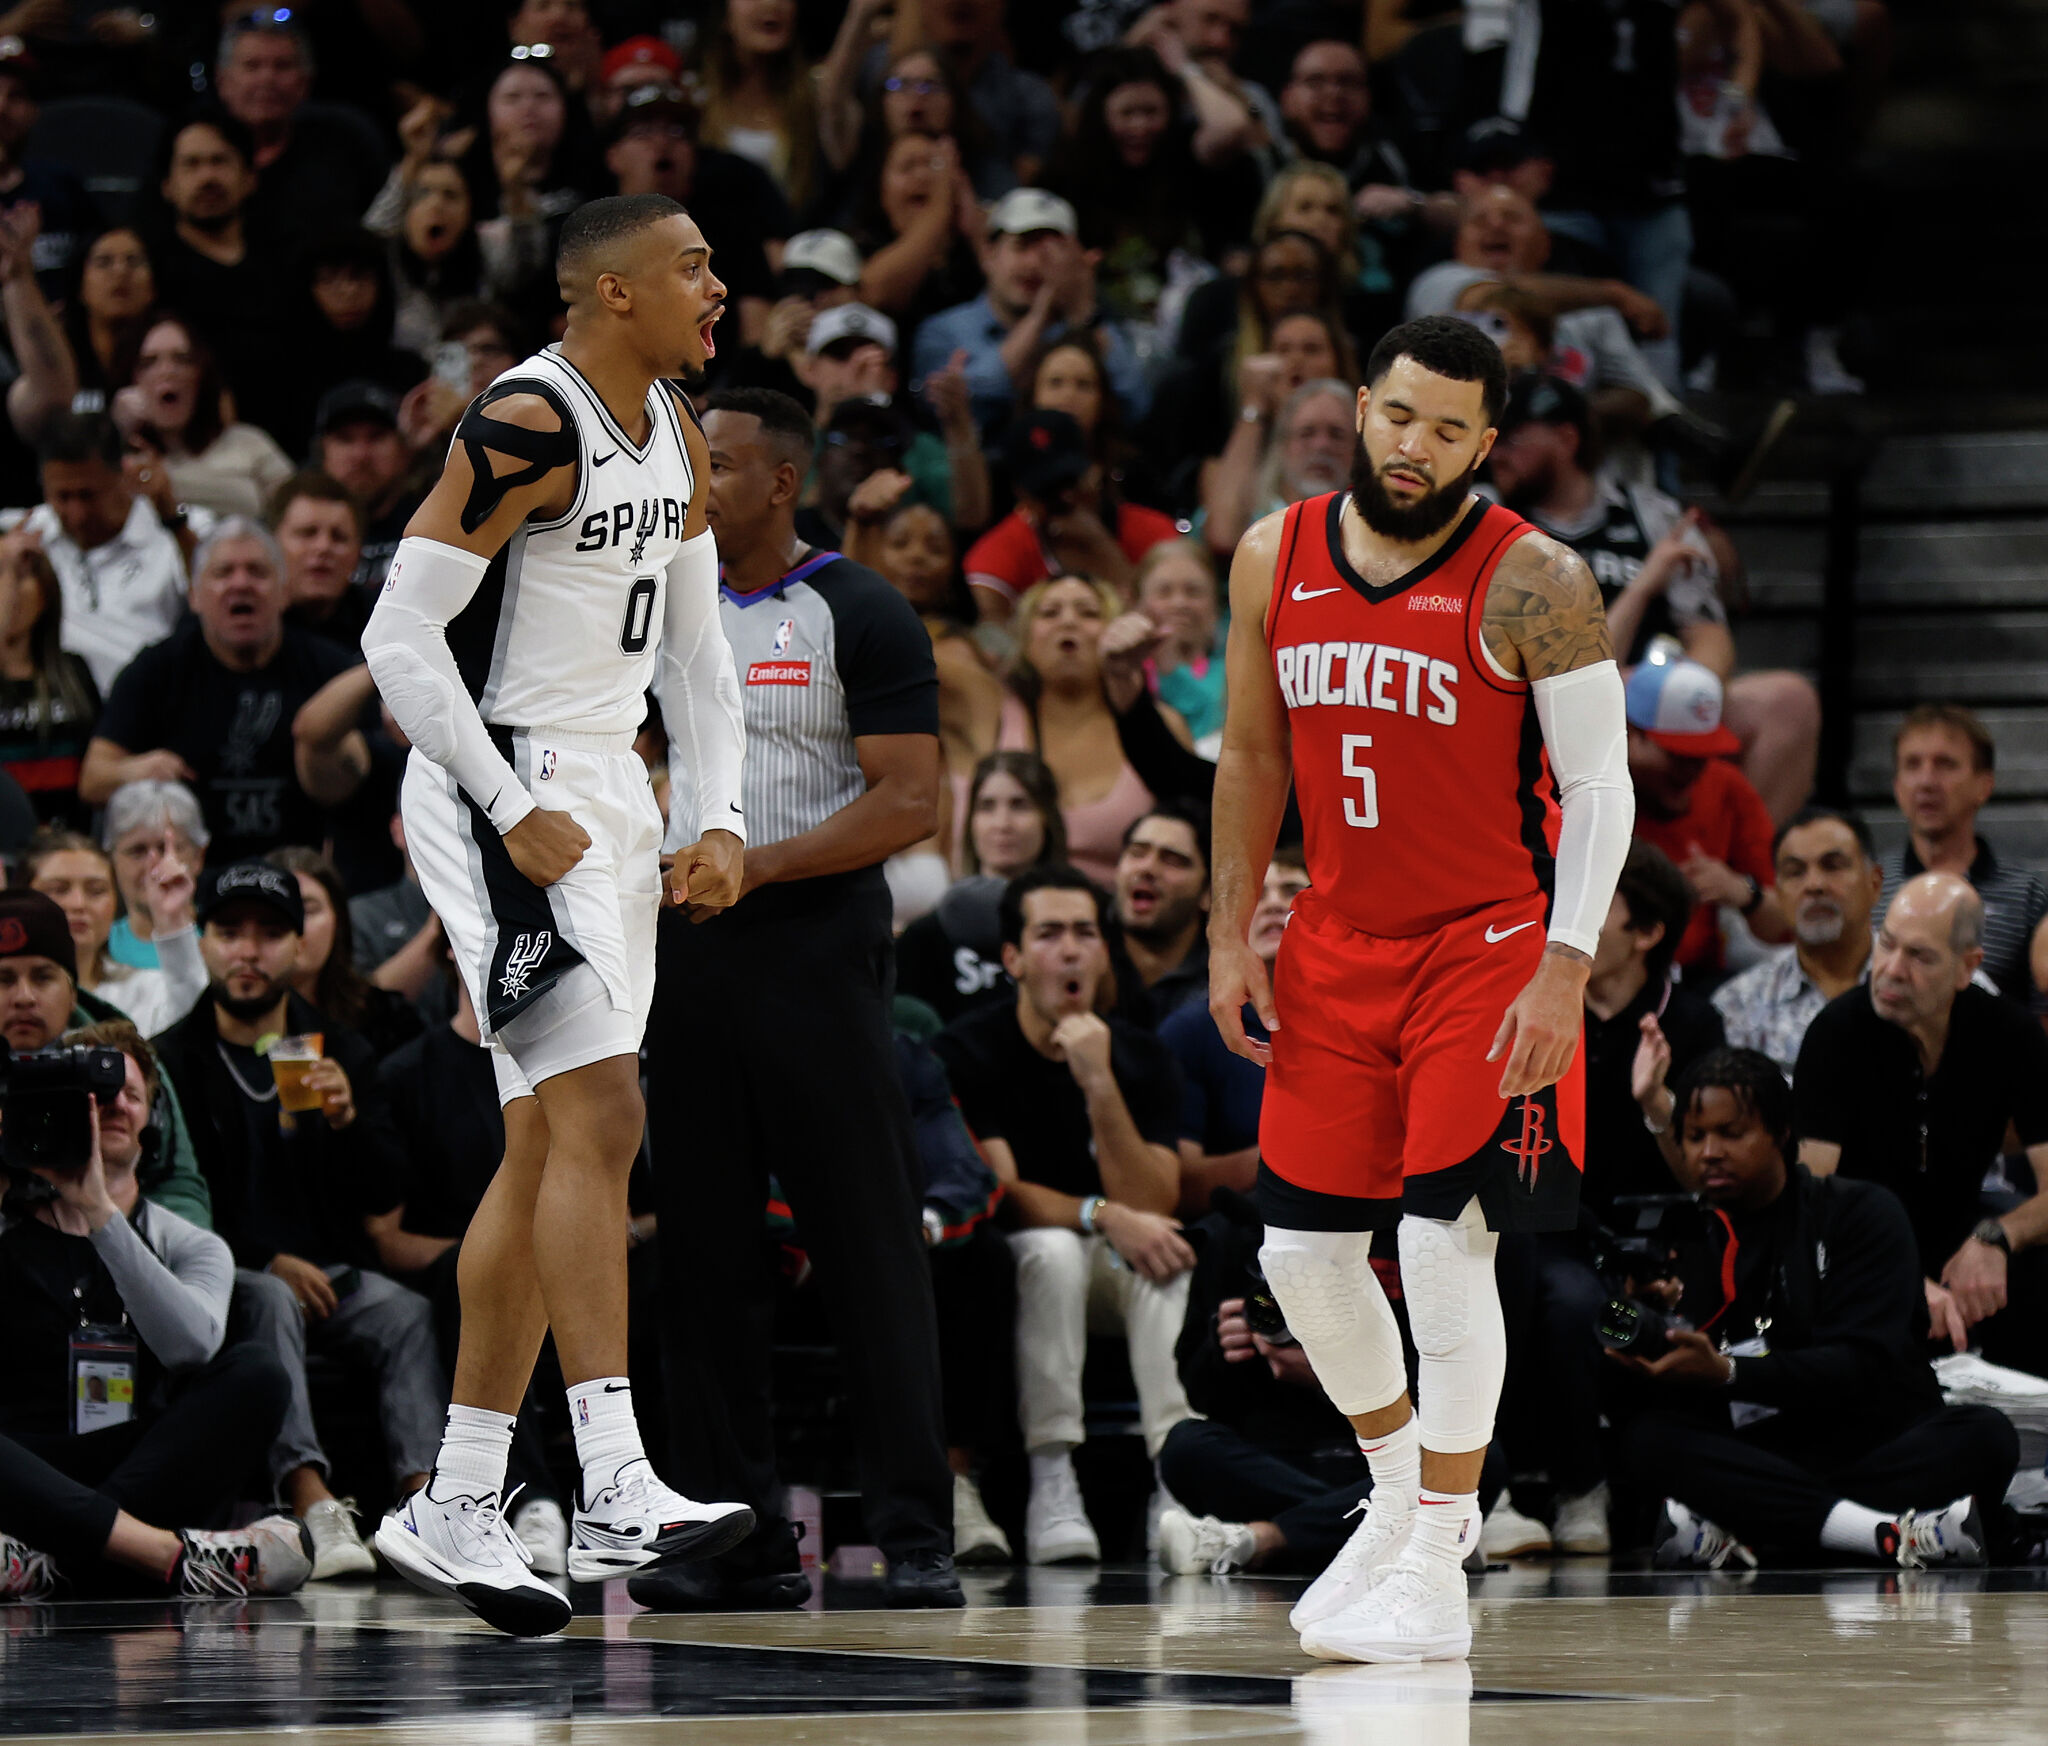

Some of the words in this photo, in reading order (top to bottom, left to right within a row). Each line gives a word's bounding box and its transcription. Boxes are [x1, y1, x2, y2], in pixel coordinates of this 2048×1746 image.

[618, 575, 658, 656] 0
[1408, 600, 1462, 613] HERMANN
[1409, 595, 1462, 607] MEMORIAL
[748, 665, 809, 682] Emirates
[1276, 641, 1459, 726] ROCKETS
[1341, 734, 1380, 829] 5
